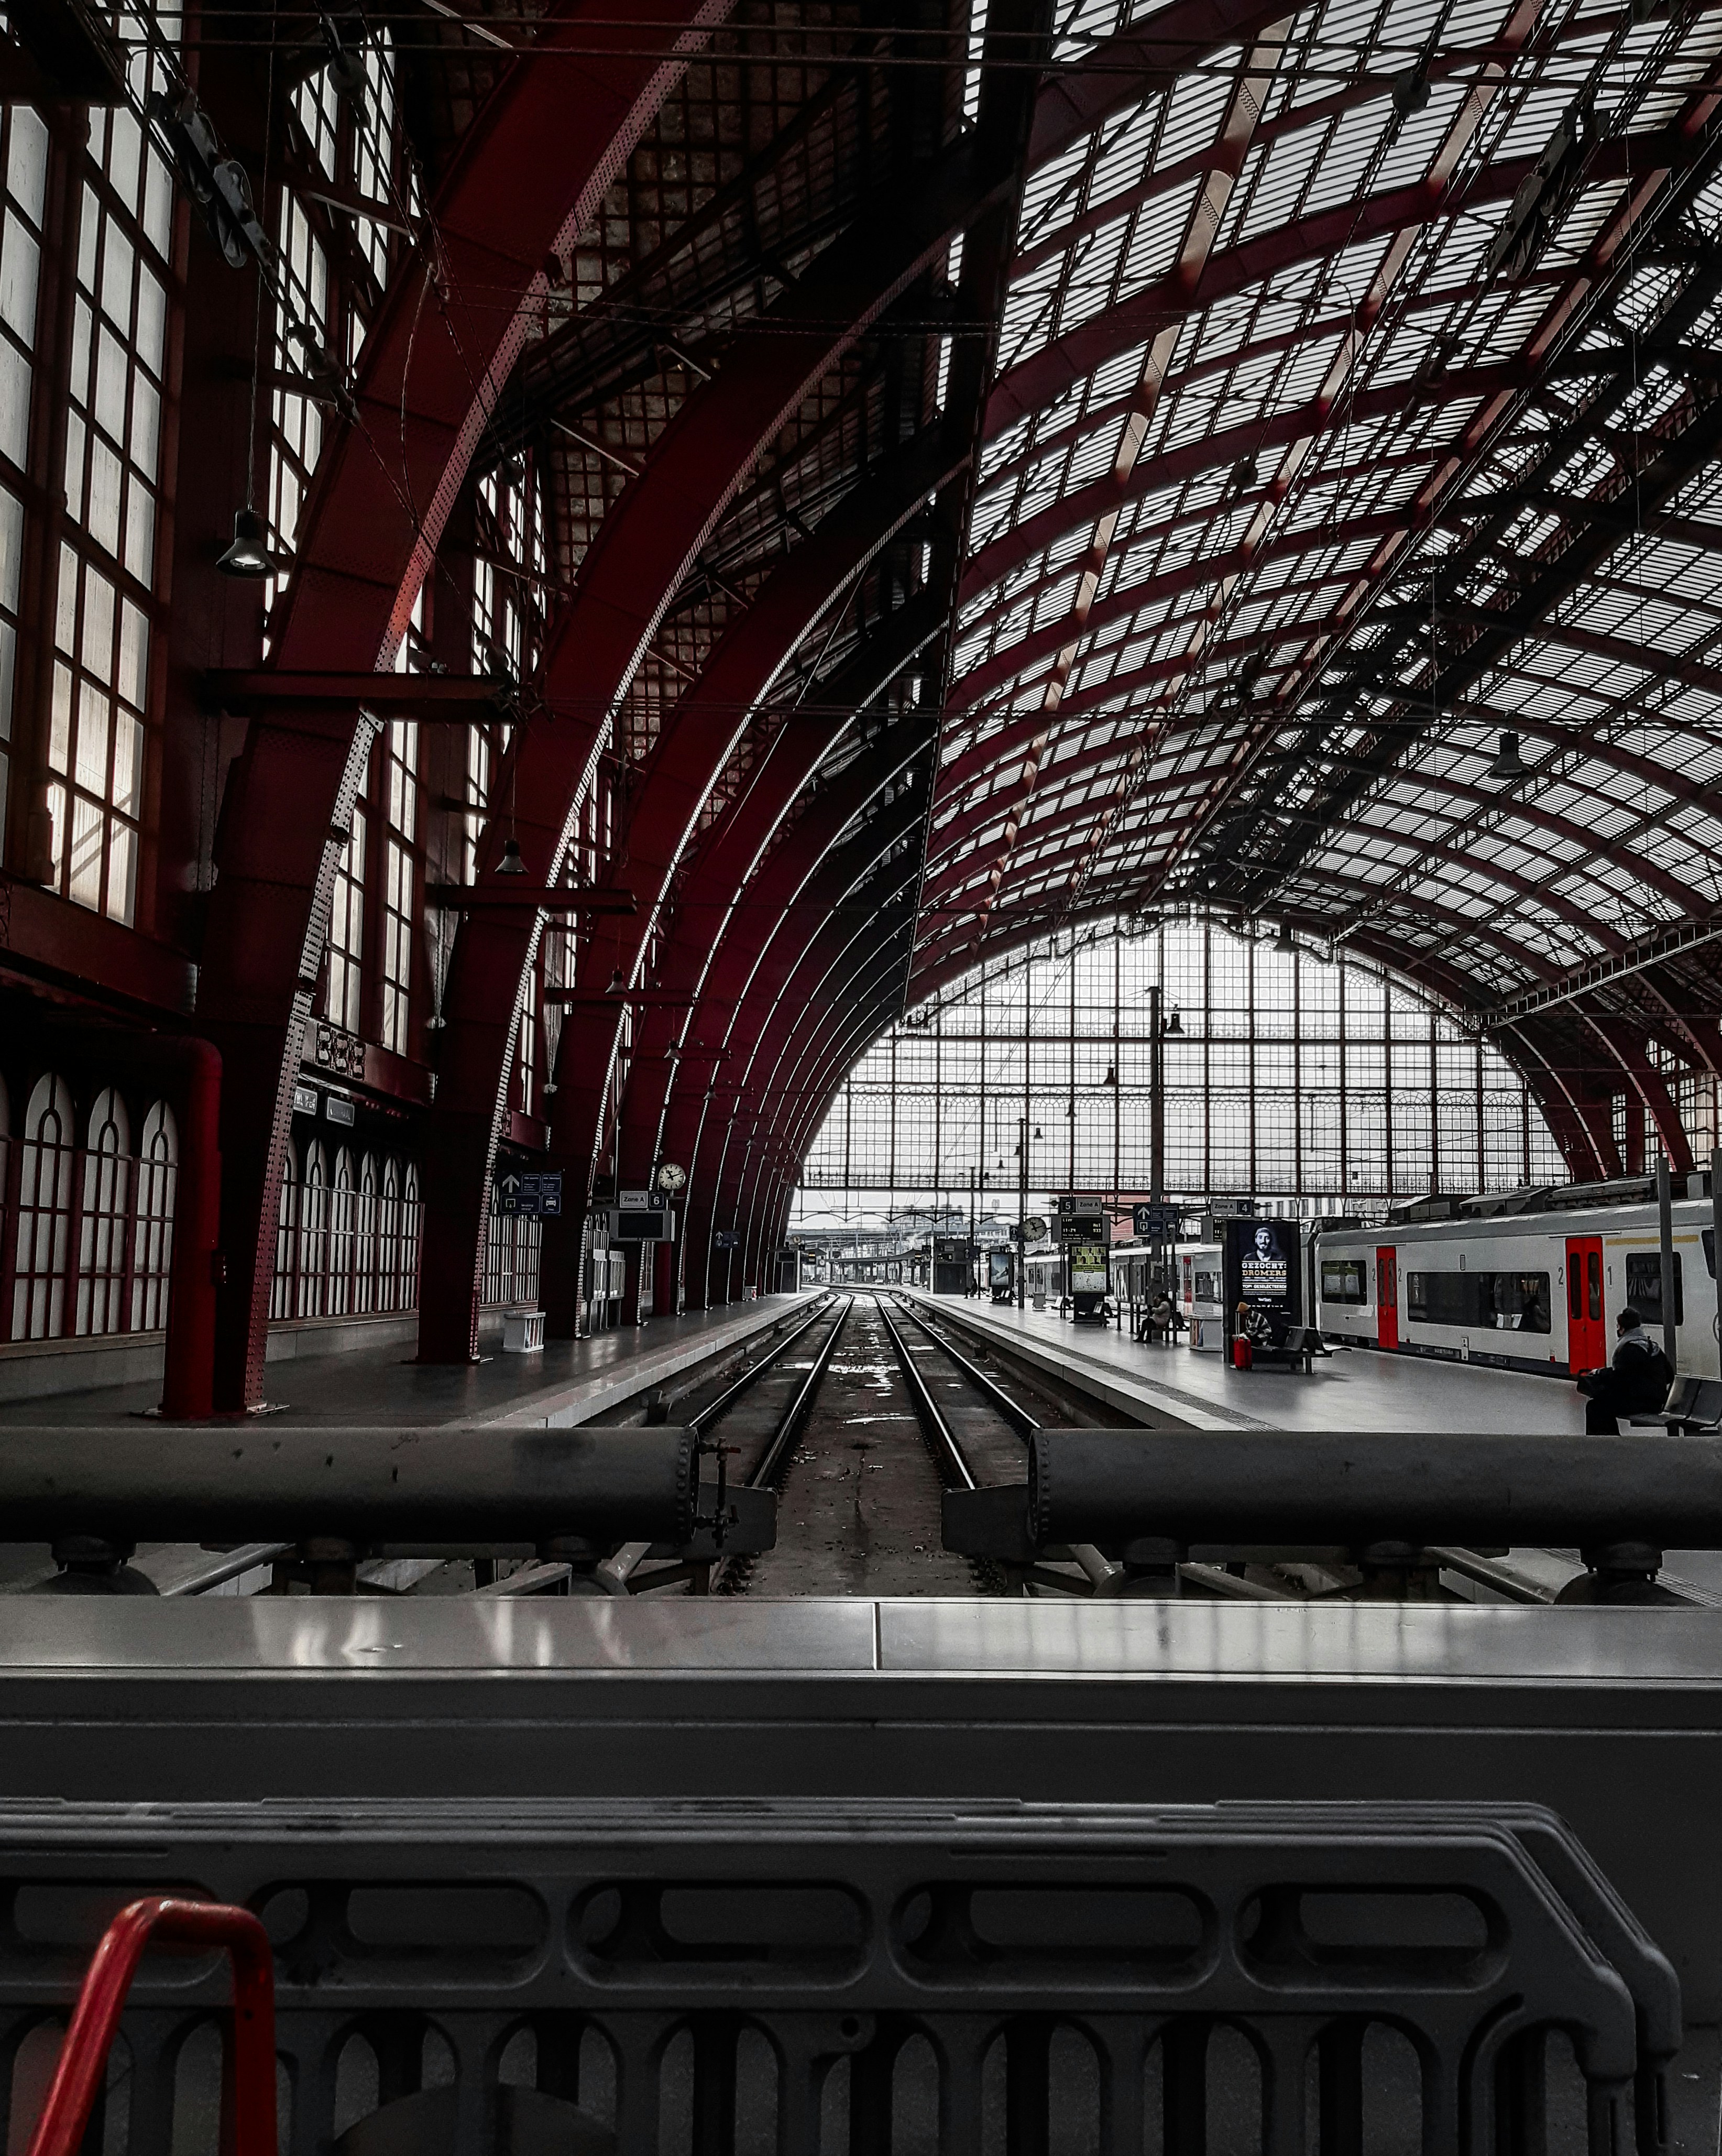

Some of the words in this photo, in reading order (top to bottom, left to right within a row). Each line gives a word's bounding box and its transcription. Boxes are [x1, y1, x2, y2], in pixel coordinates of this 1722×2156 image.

[653, 1196, 660, 1205] 6
[1065, 1201, 1071, 1210] 5
[1242, 1204, 1248, 1212] 4
[1372, 1268, 1376, 1281] 2
[1398, 1268, 1401, 1282] 2
[1558, 1267, 1564, 1285] 2
[1607, 1266, 1612, 1285] 1
